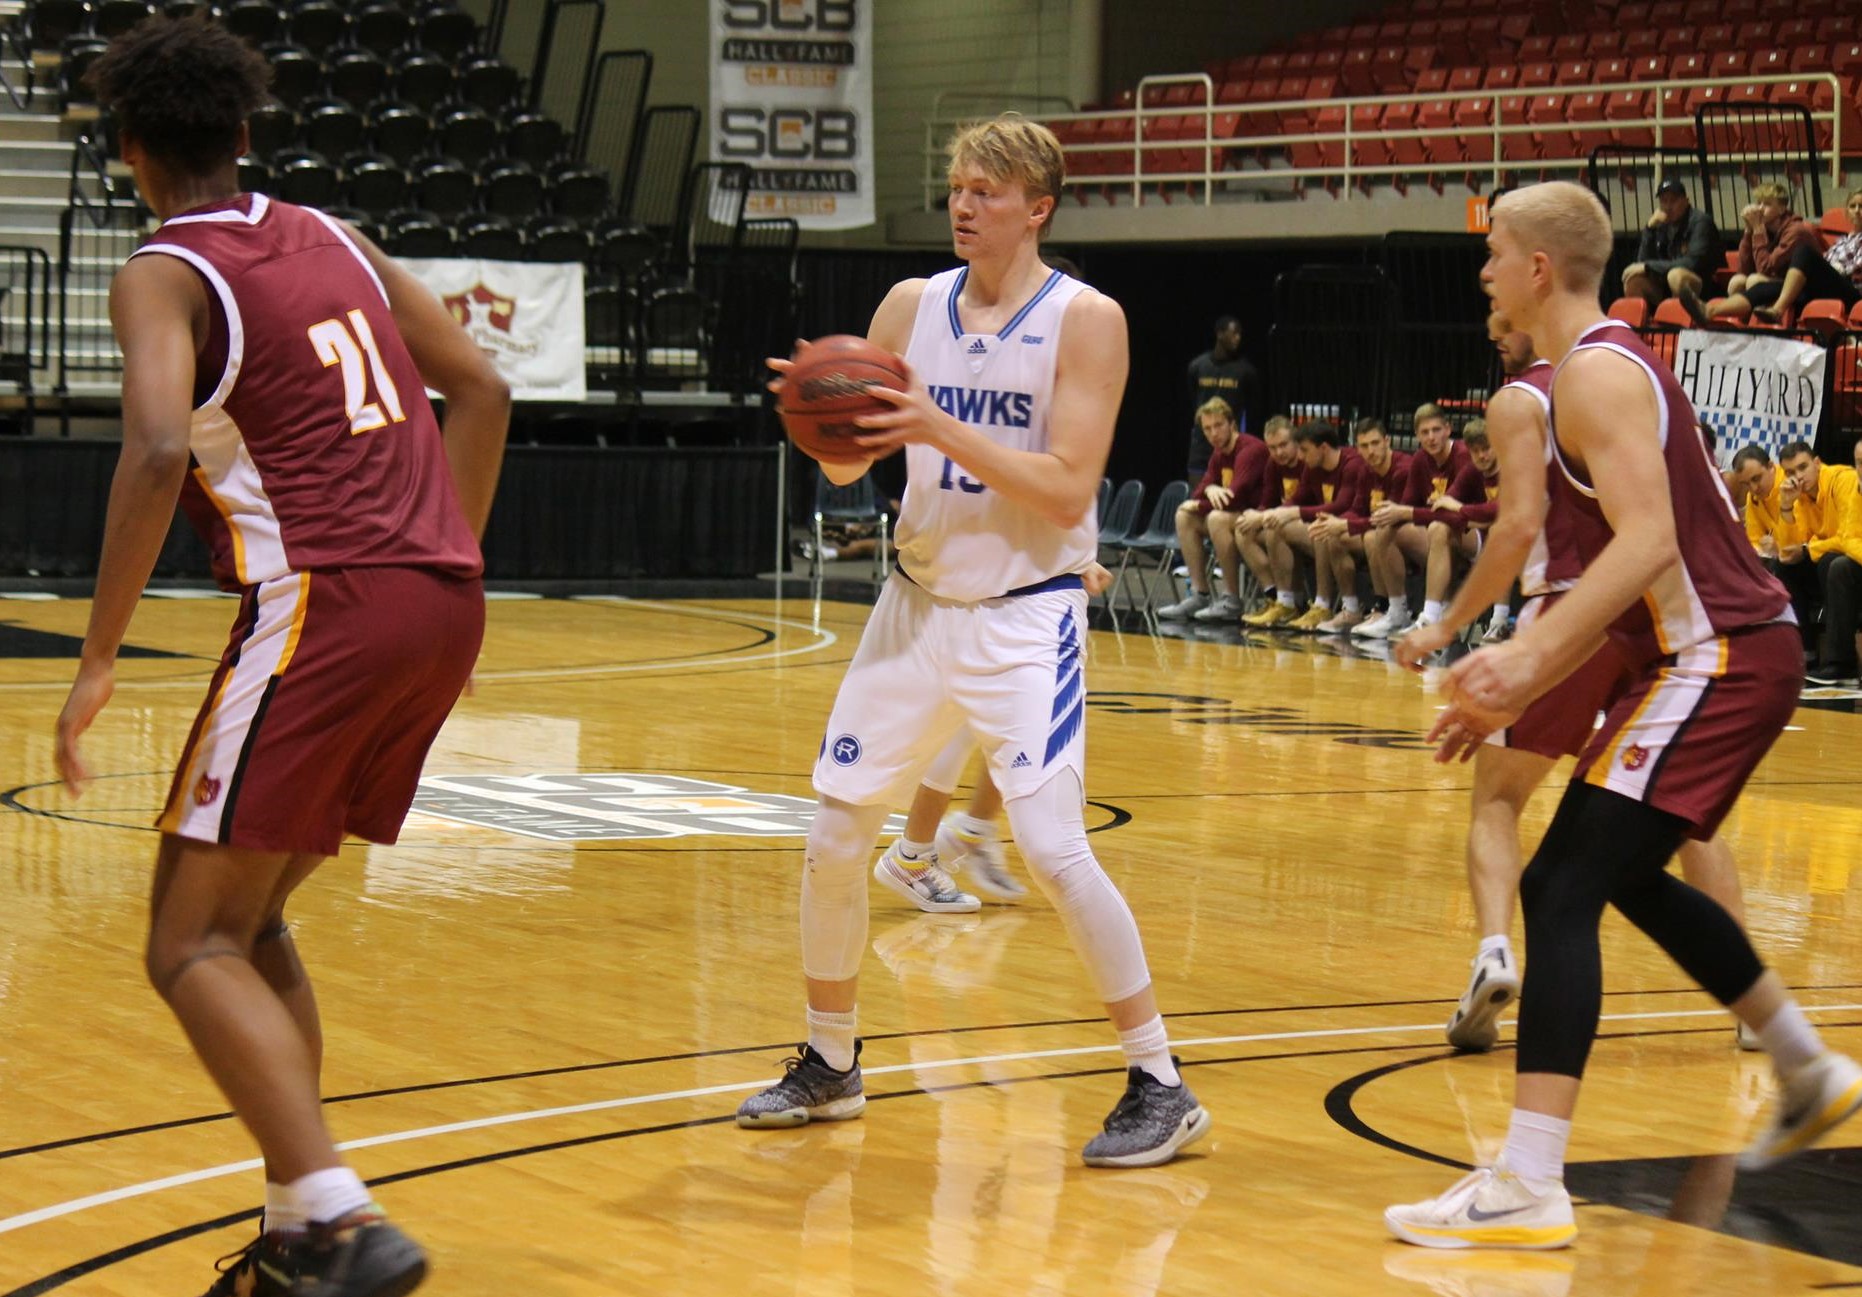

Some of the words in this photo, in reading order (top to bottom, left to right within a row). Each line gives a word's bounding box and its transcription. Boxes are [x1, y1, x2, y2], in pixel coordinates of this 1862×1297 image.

[722, 0, 857, 31] SCB
[728, 42, 781, 60] HALL
[720, 107, 857, 159] SCB
[726, 171, 780, 189] HLL
[795, 171, 850, 190] FAME
[307, 308, 407, 436] 21
[928, 384, 1033, 429] AWKS
